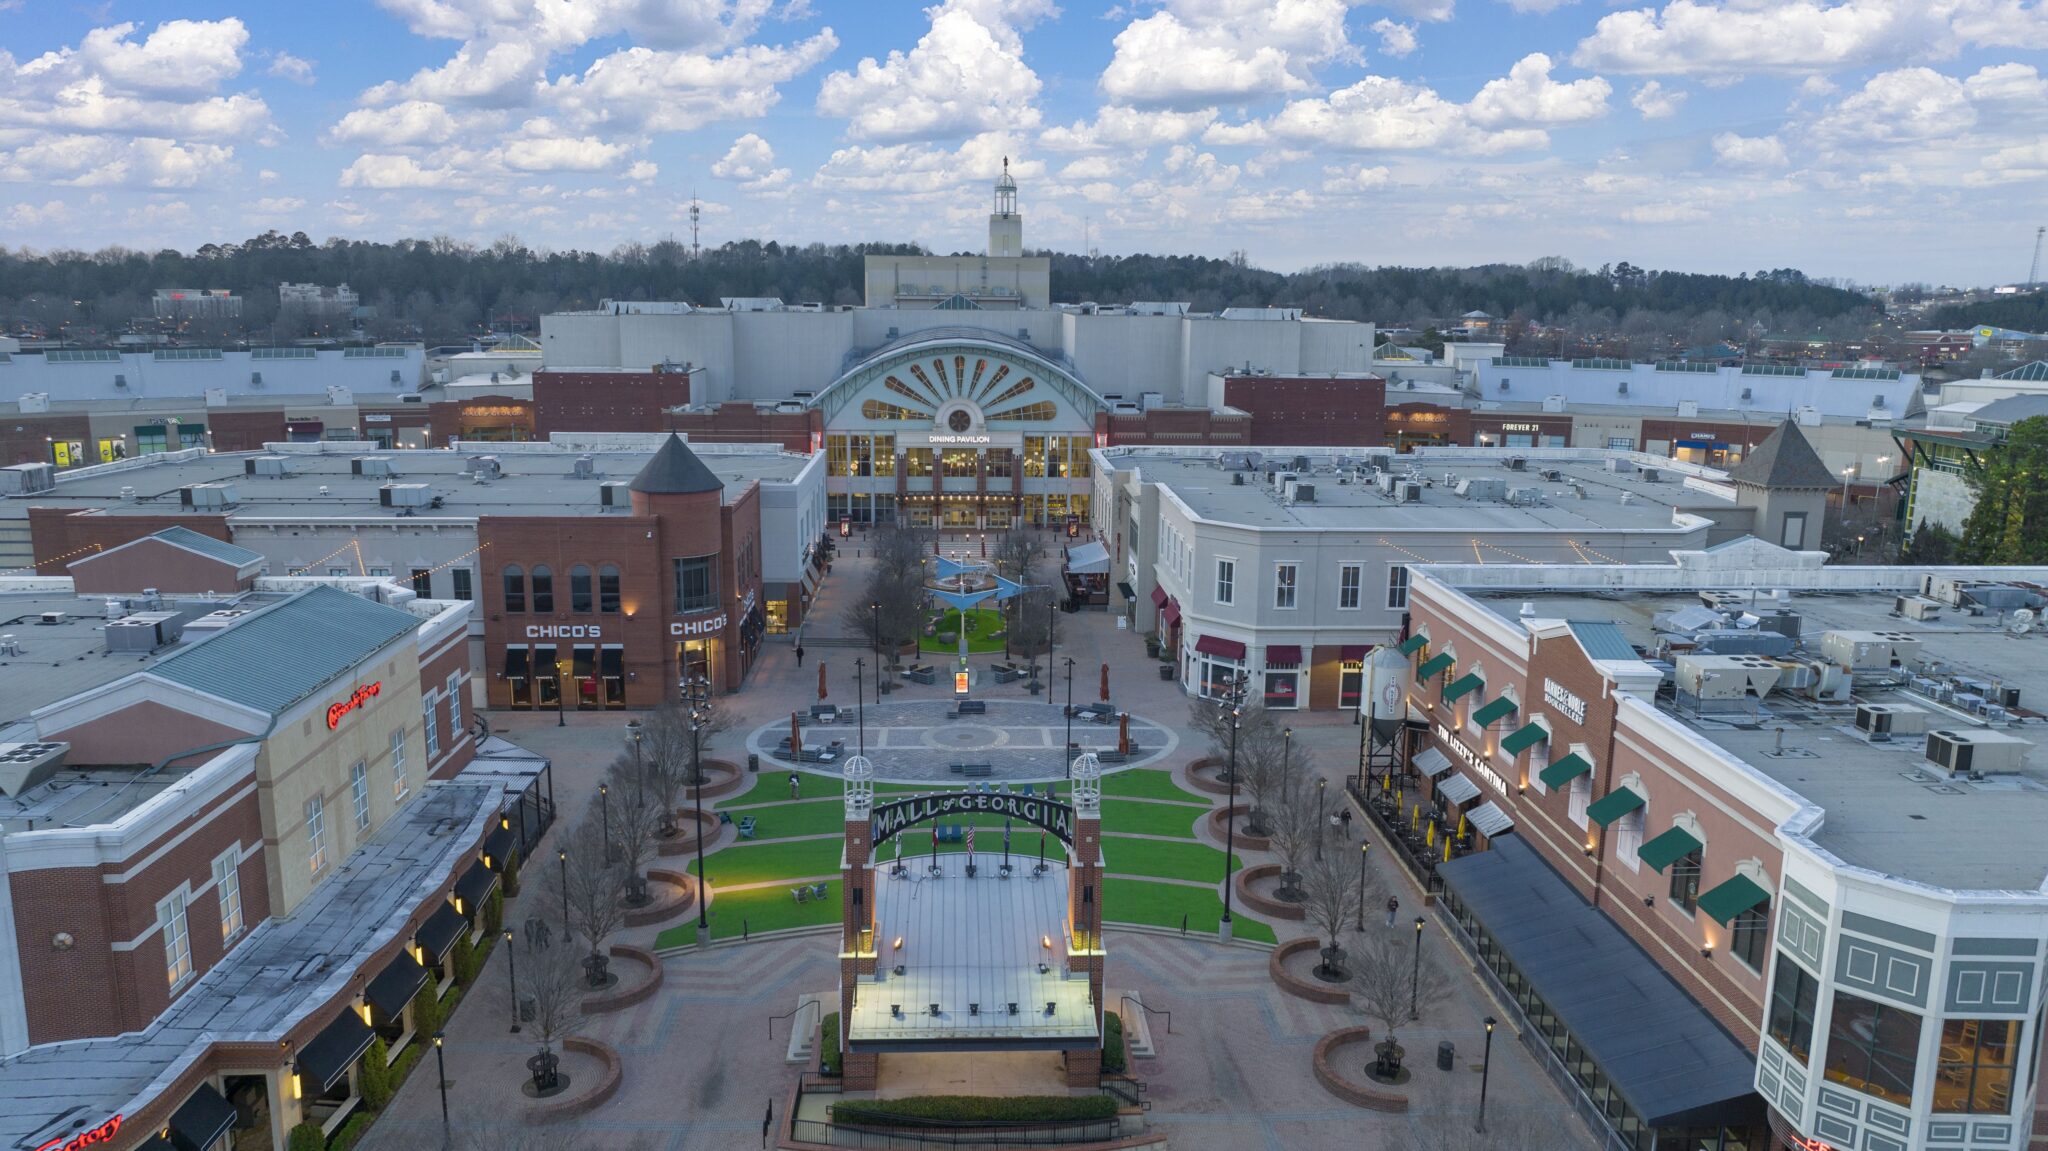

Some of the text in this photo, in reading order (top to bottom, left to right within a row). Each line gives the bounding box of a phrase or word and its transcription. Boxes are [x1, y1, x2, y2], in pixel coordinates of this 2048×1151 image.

[929, 435, 990, 443] DINING PAVILION
[1502, 423, 1539, 432] FOREVER 21
[526, 624, 601, 638] CHICO'S
[671, 613, 727, 635] CHICO'S
[1544, 677, 1563, 702] BARNES
[1568, 692, 1586, 717] NOBLE
[1544, 692, 1584, 726] BOOKSELLERS
[1437, 723, 1507, 796] TIN LIZZY'S CANTINA
[877, 795, 1068, 840] MALL of GEORGIA
[33, 1113, 123, 1151] ctory
